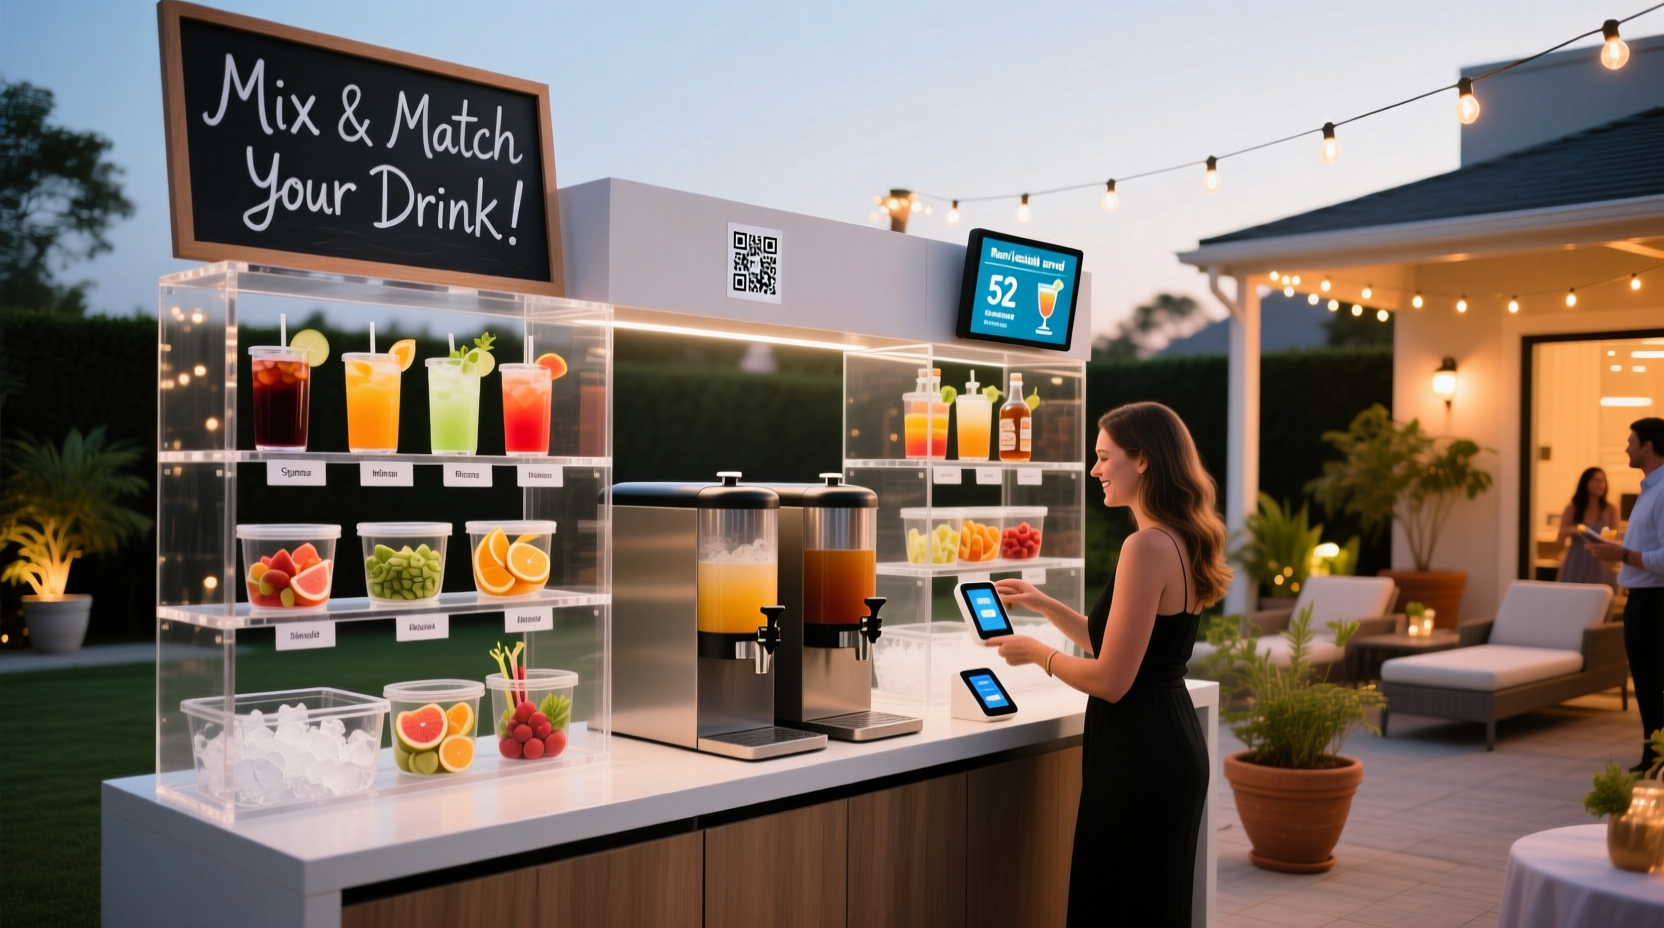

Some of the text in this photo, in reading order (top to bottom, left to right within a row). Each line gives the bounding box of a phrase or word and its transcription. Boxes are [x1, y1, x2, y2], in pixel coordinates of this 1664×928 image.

[202, 53, 523, 164] Mix & Match
[242, 146, 524, 246] Your Drink!
[986, 274, 1018, 308] 52
